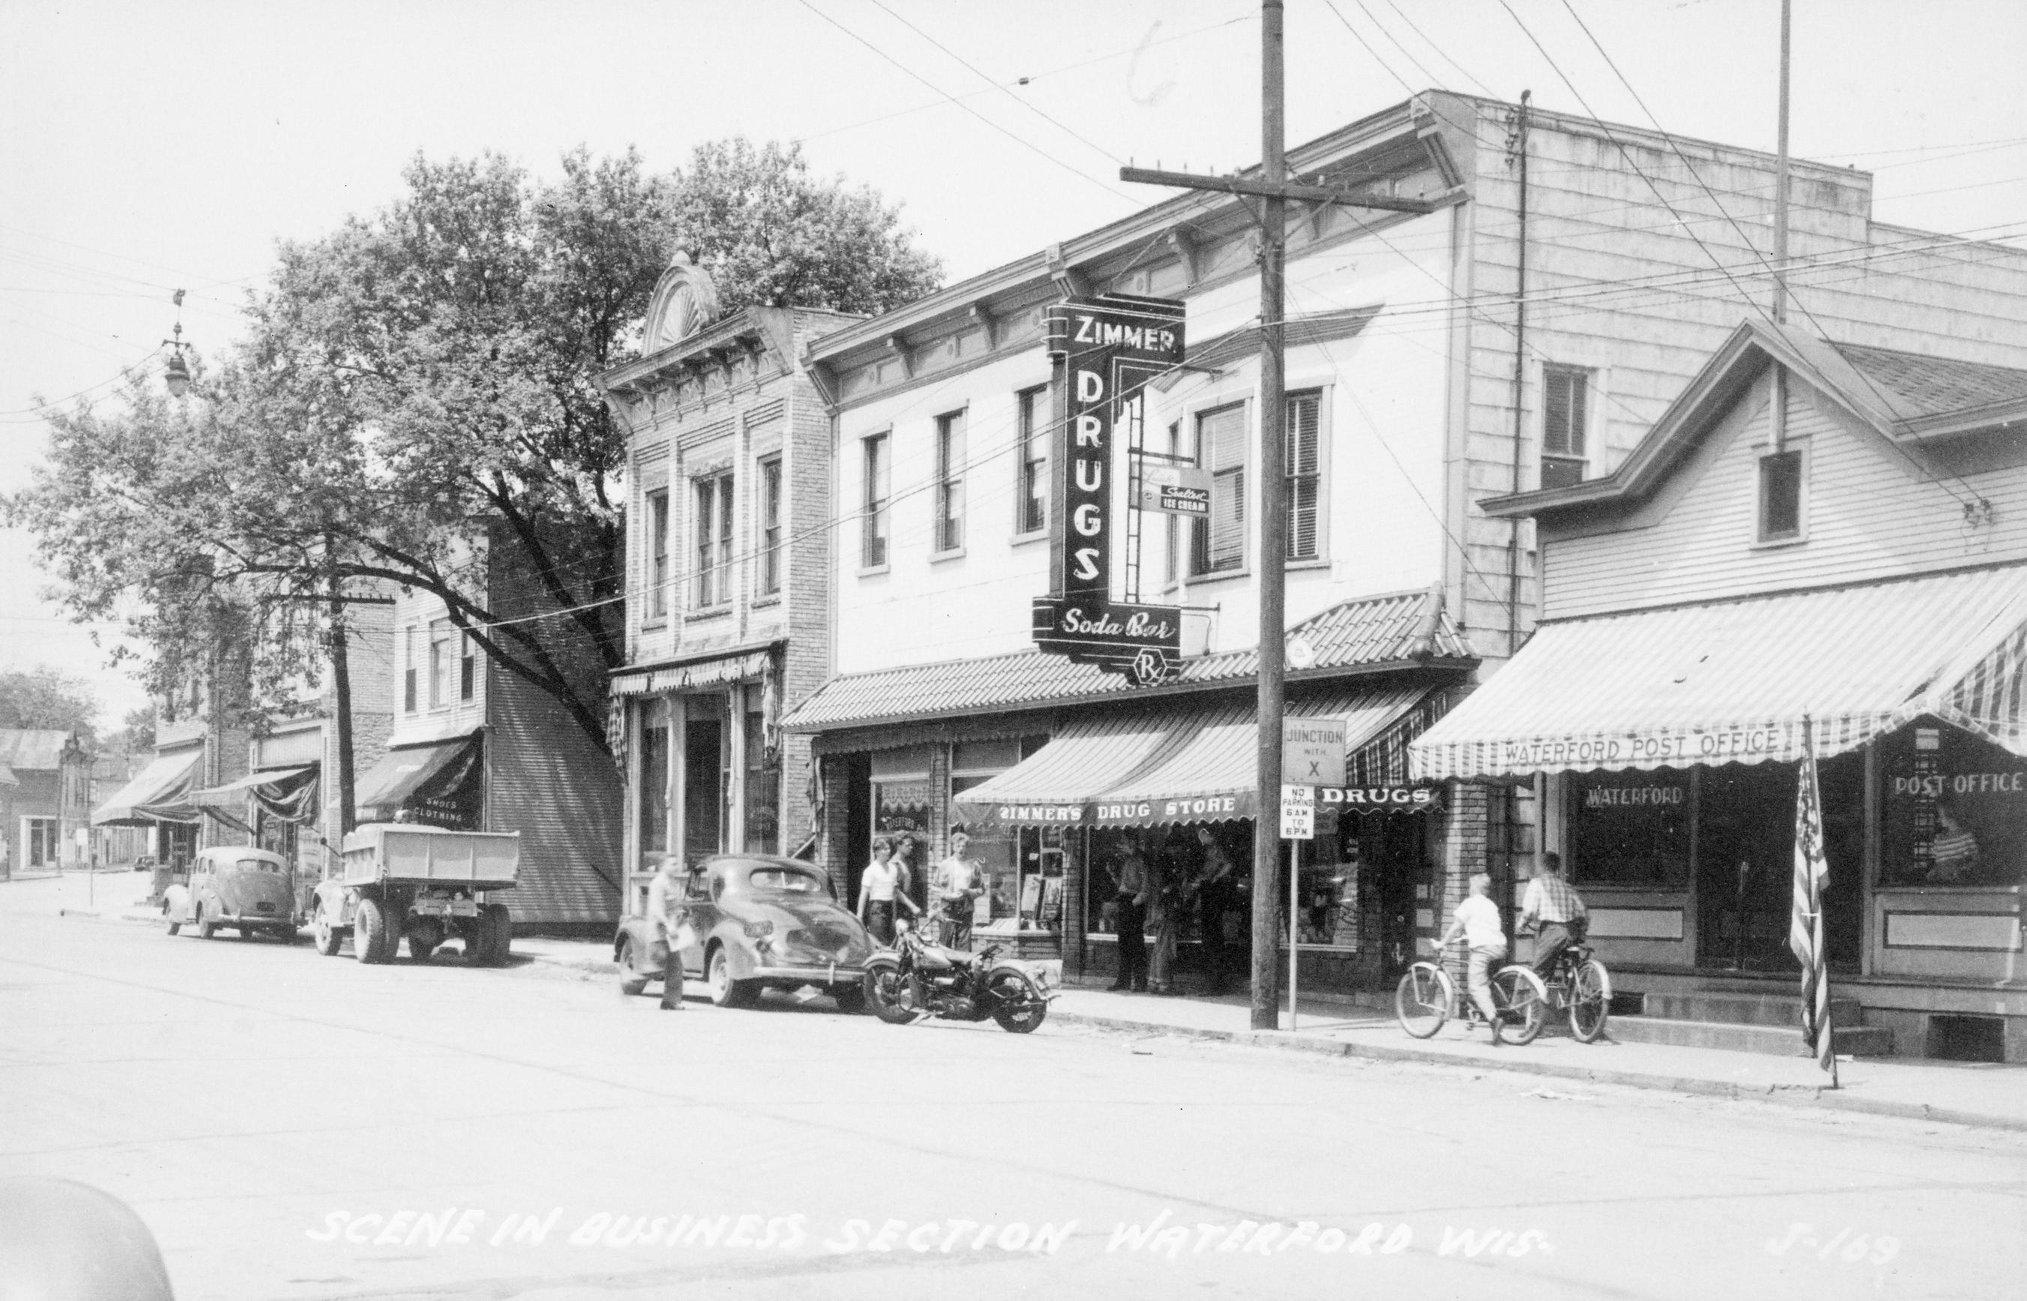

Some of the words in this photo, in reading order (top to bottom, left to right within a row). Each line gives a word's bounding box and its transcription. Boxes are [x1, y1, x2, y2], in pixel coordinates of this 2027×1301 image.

[1073, 369, 1103, 580] DRUGS
[1163, 498, 1177, 509] ICE
[1177, 499, 1206, 512] CREAM
[1061, 607, 1124, 635] Soda
[1125, 611, 1176, 639] Bar
[1286, 728, 1343, 744] JUNCTION
[1303, 747, 1327, 756] WITH
[1505, 740, 1620, 766] WATERFORD
[1630, 736, 1687, 759] POST
[1700, 729, 1780, 755] OFFICE
[1308, 760, 1320, 777] X
[1895, 775, 1947, 795] POST
[1954, 772, 2024, 793] OFFICE
[1291, 788, 1305, 798] NO
[1321, 787, 1431, 803] DRUGS
[1585, 786, 1683, 806] WATERFORD
[426, 798, 457, 809] SHOES
[1097, 803, 1151, 819] DRUG
[1164, 797, 1236, 816] STORE
[1282, 798, 1313, 808] PARKING
[413, 807, 462, 822] CLOTHING
[1292, 818, 1304, 826] TO
